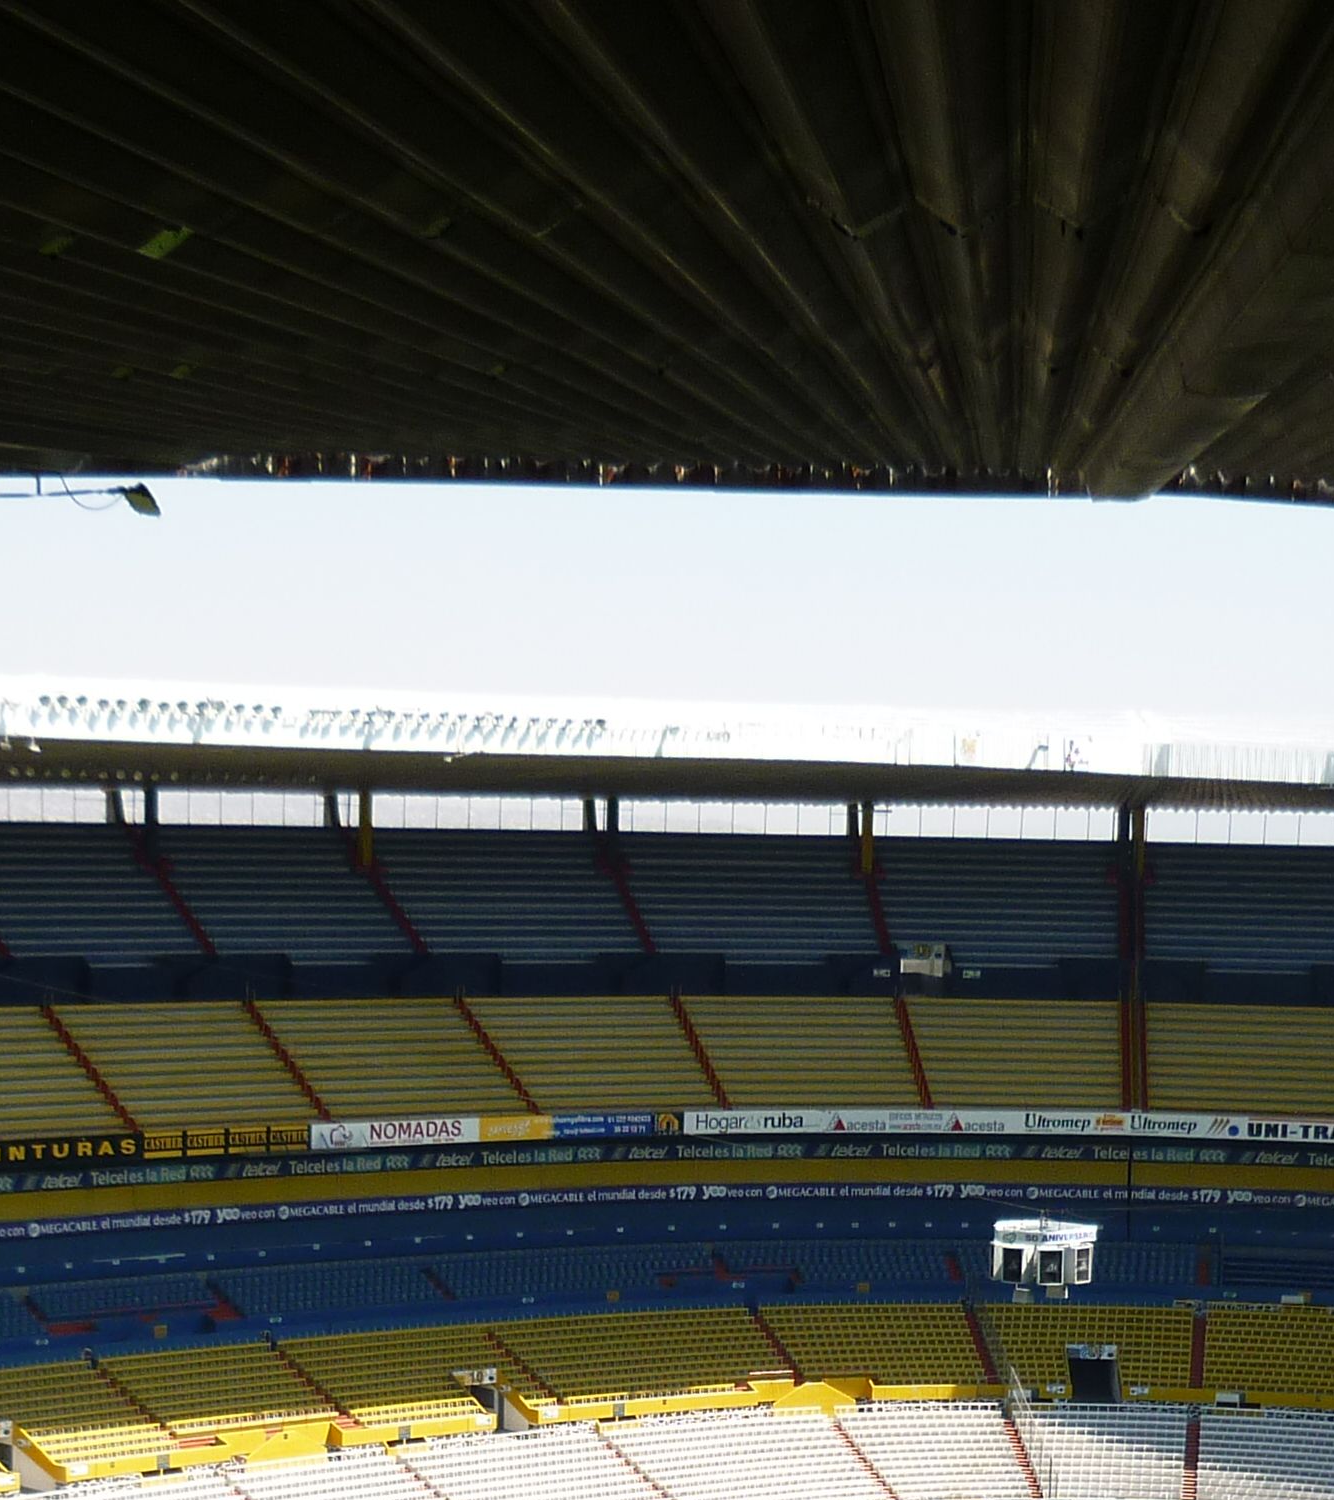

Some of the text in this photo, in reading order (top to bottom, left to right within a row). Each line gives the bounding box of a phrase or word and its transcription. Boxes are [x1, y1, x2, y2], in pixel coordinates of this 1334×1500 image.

[370, 1120, 463, 1141] NOMADAS
[695, 1113, 745, 1135] Hogar
[763, 1112, 804, 1129] ruba
[964, 1120, 1005, 1133] acesta
[548, 1148, 573, 1162] Red
[1151, 1145, 1163, 1160] la
[1166, 1146, 1194, 1161] Red
[427, 1194, 454, 1210] $179
[530, 1192, 584, 1204] MEGACABLE
[587, 1190, 597, 1202] el
[597, 1188, 636, 1202] mundial
[638, 1187, 666, 1200] desde
[669, 1186, 697, 1200] $179
[777, 1186, 836, 1198] MEGACABLE
[840, 1186, 850, 1197] el
[851, 1185, 891, 1197] mundial
[893, 1185, 923, 1197] desde
[926, 1184, 955, 1198] $179
[1039, 1188, 1100, 1199] MEGACABLE
[1103, 1190, 1113, 1200] el
[1158, 1190, 1189, 1202] desde
